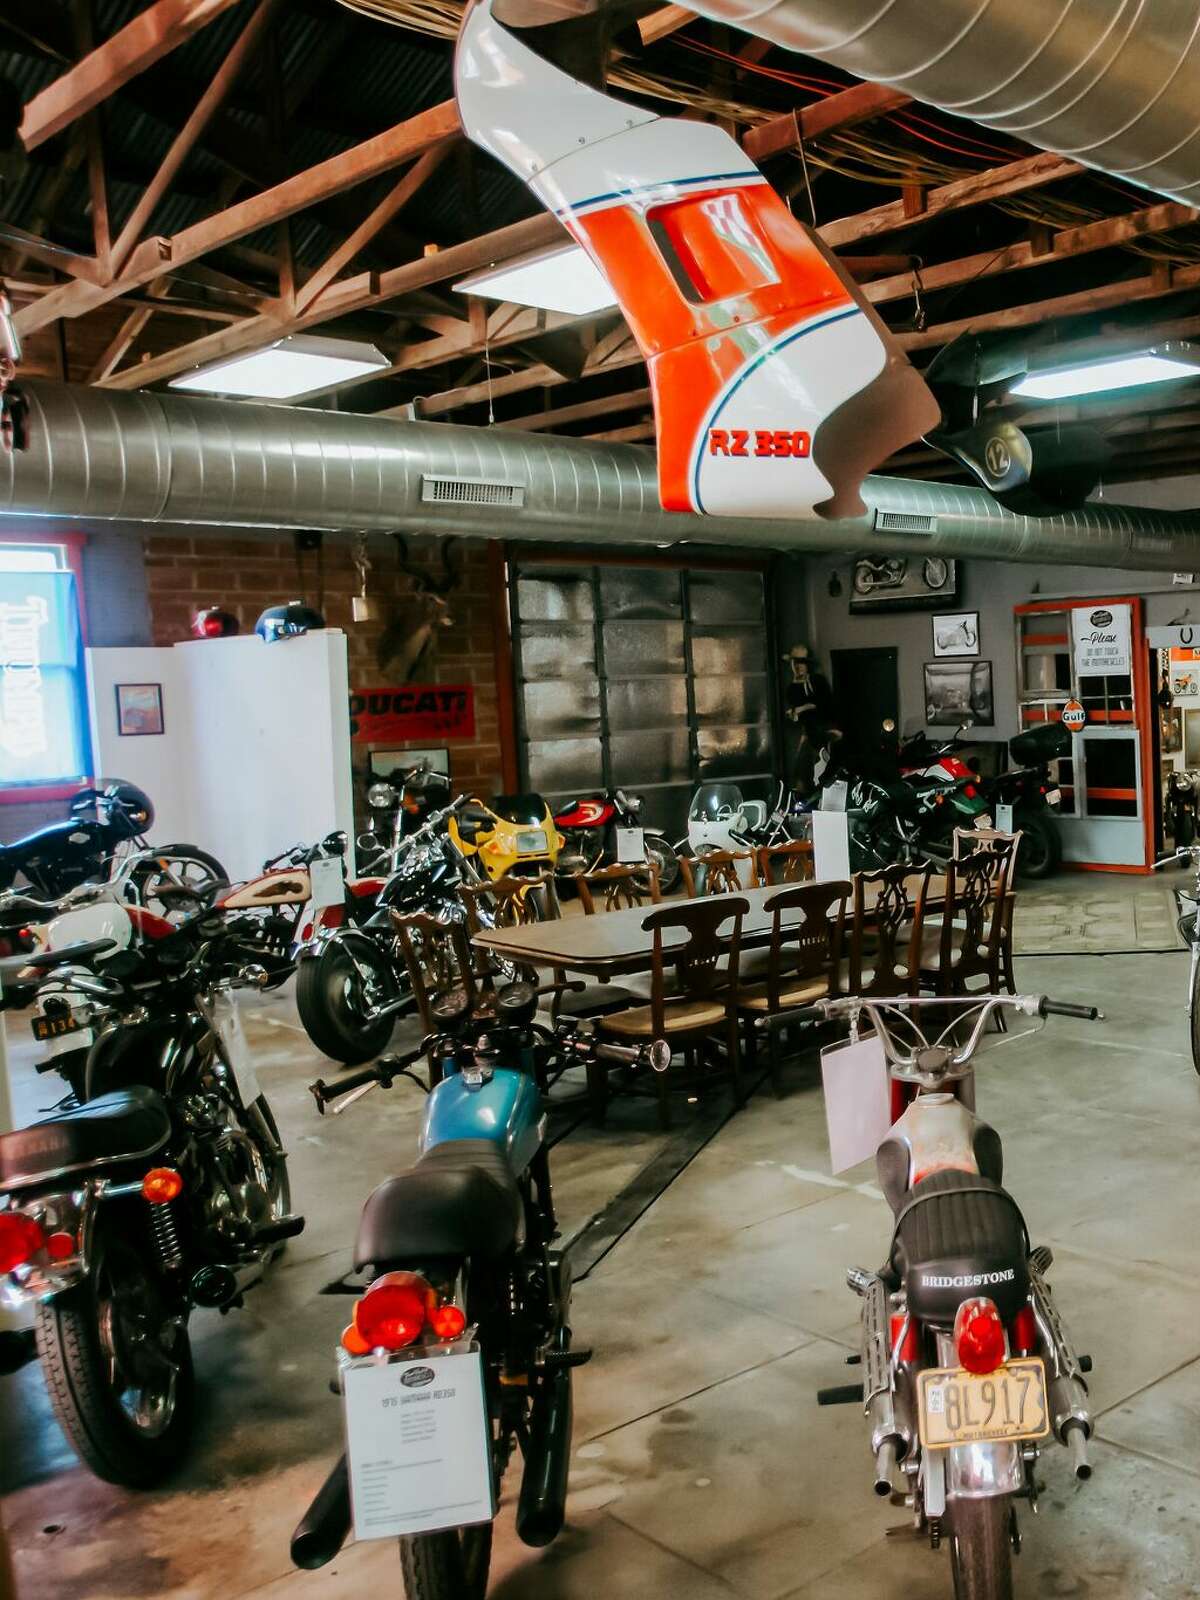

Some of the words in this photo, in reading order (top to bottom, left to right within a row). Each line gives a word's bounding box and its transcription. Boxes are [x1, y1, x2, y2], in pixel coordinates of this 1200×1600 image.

[709, 430, 749, 457] RZ
[754, 431, 811, 458] 350
[989, 442, 1008, 470] 12
[1081, 631, 1117, 645] Please
[1063, 712, 1086, 721] Gulf
[921, 1268, 1015, 1288] BRIDGESTONE
[943, 1376, 1031, 1431] 8L917
